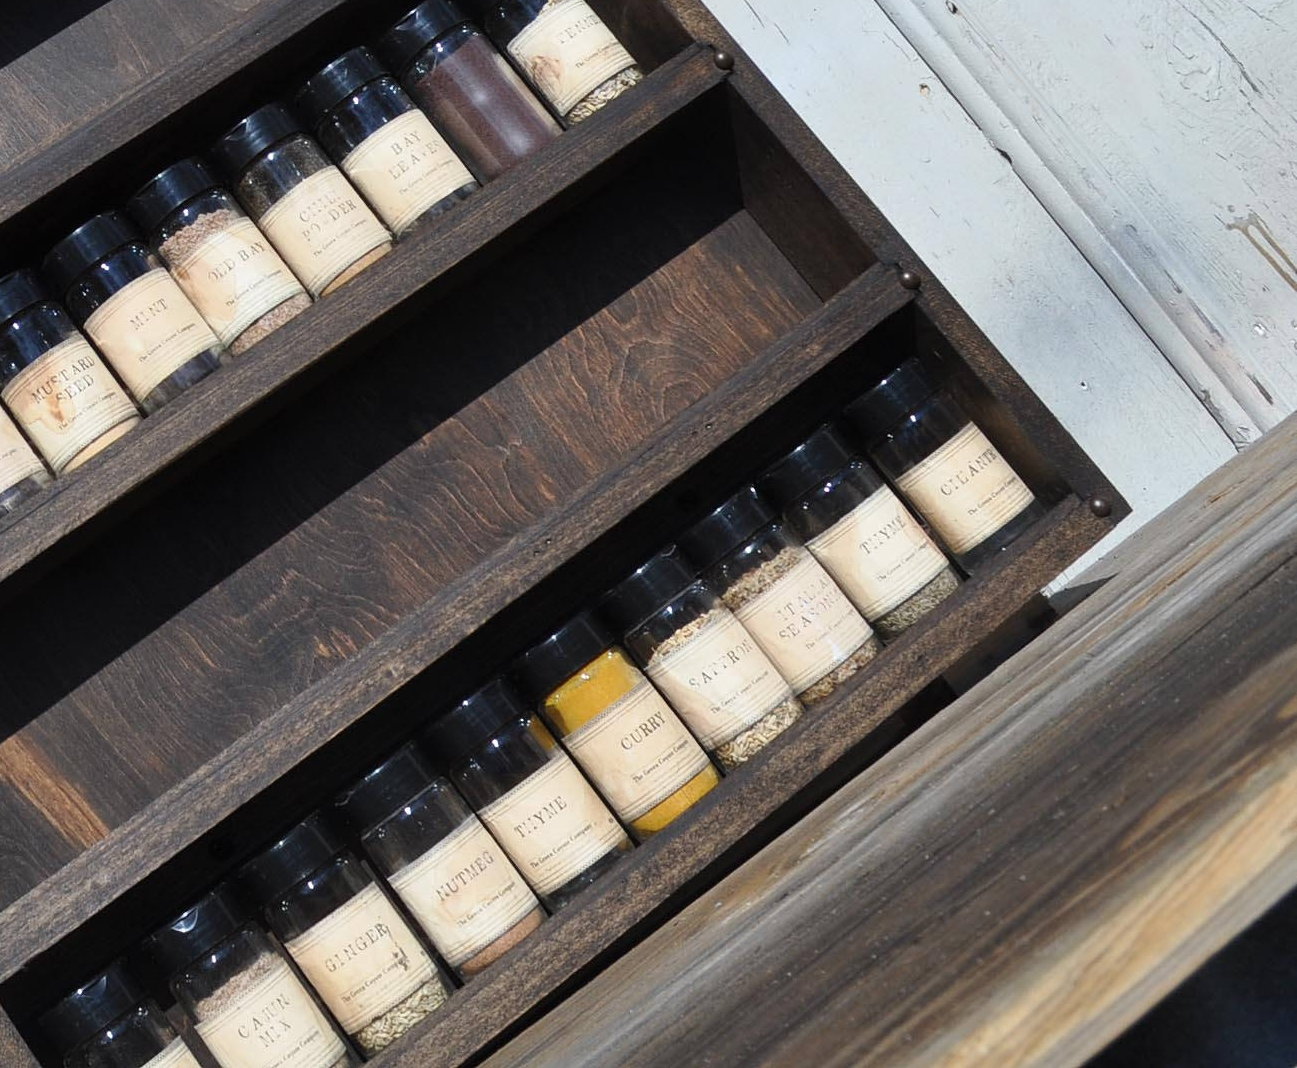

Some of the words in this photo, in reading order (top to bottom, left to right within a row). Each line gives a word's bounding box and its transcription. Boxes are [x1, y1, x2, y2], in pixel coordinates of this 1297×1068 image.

[388, 139, 442, 182] LEAES
[389, 129, 423, 157] BAY
[301, 198, 358, 244] PODER
[206, 259, 236, 284] OLD
[238, 240, 267, 264] BAY
[128, 296, 168, 331] MINT
[30, 354, 96, 404] MUSTARD
[55, 373, 95, 402] SEED
[939, 447, 999, 498] CILANTR
[774, 576, 831, 624] ITALIA
[620, 711, 667, 752] CURRY
[513, 795, 569, 840] THYME
[435, 850, 495, 902] NUTMEG
[325, 921, 390, 973] GINGER
[237, 992, 291, 1040] CAJUN
[257, 1019, 293, 1049] MIX
